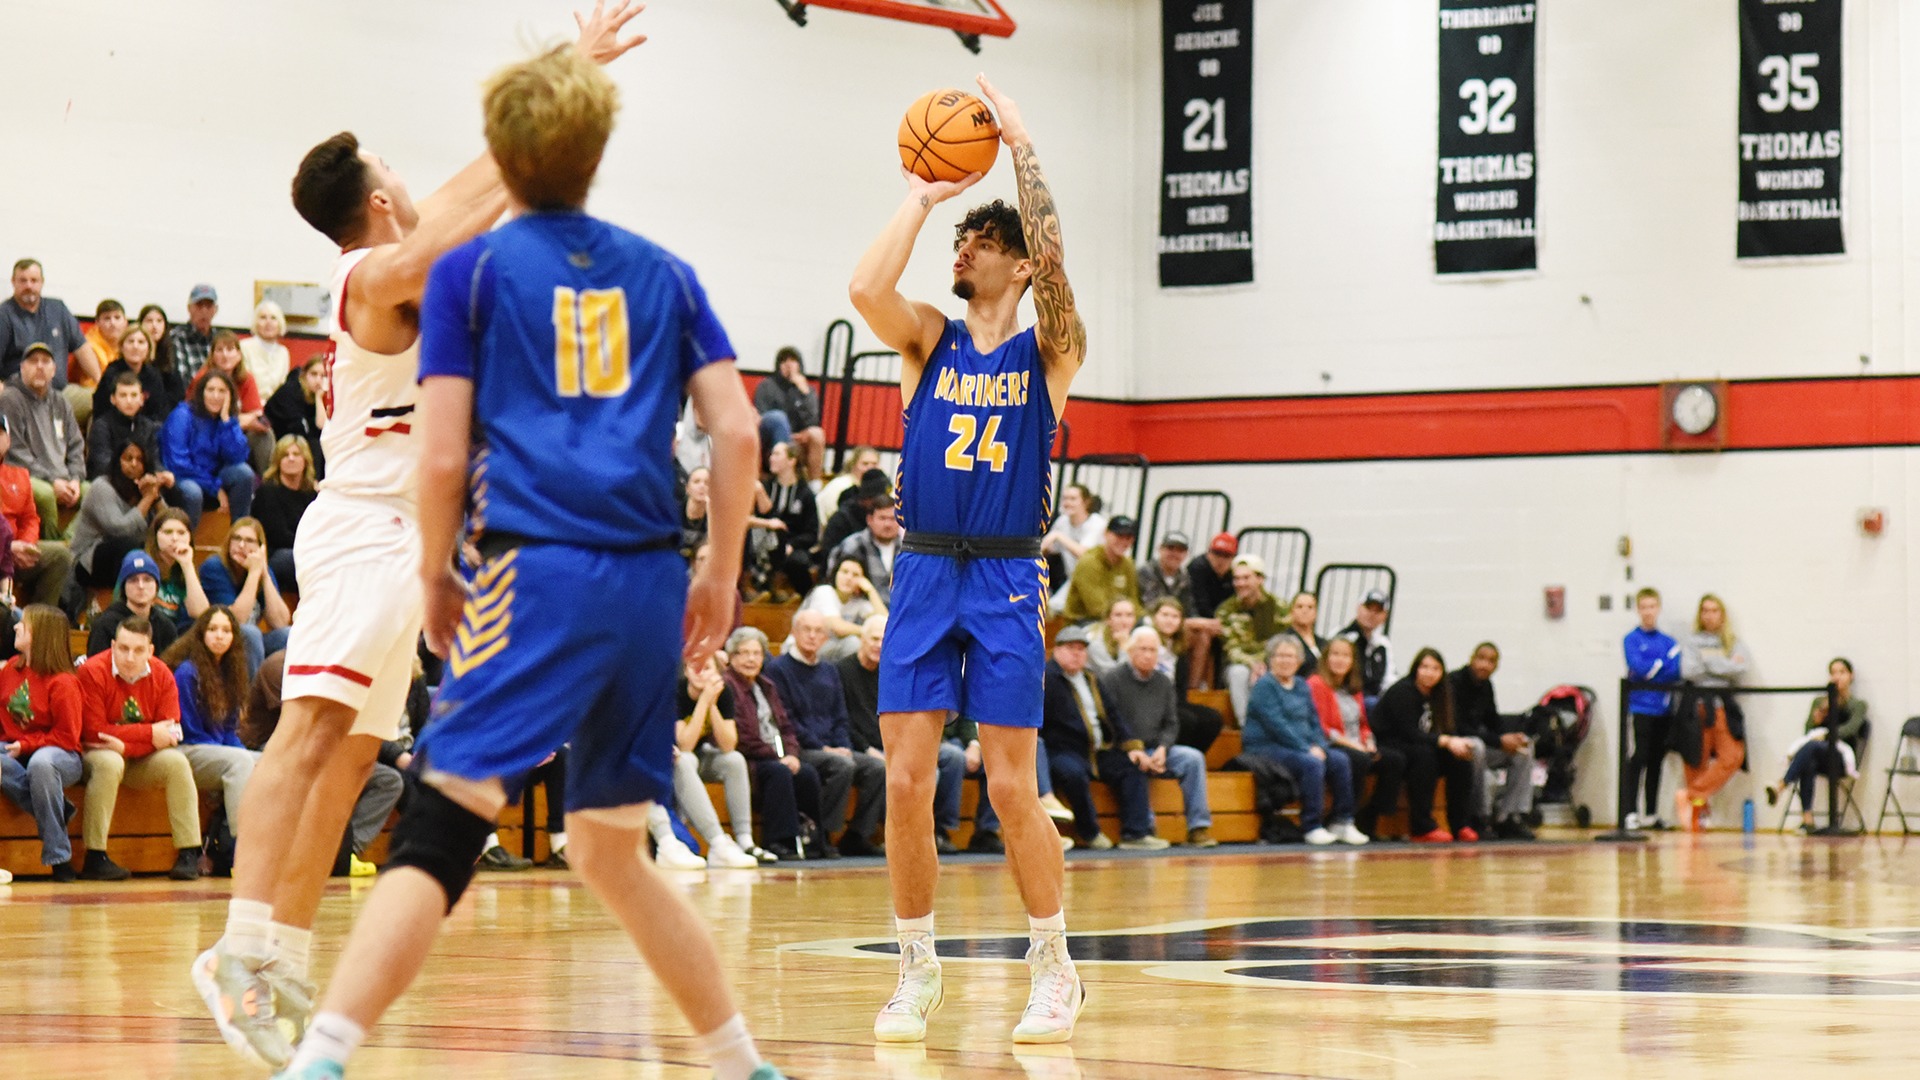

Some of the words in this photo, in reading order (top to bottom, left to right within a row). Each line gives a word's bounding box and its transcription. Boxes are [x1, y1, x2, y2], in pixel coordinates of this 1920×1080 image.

[1757, 52, 1820, 113] 35
[1458, 77, 1518, 135] 32
[1182, 97, 1228, 152] 21
[1739, 129, 1841, 161] THOMAS
[1165, 168, 1250, 199] THOMAS
[1439, 152, 1534, 185] THOMAS
[1755, 167, 1825, 191] WOMENS
[1738, 197, 1842, 222] BASKETBALL
[1156, 230, 1252, 254] BASKETBALL
[1436, 217, 1535, 242] BASKETBALL
[552, 285, 632, 398] 10
[933, 366, 1030, 407] MARINERS
[945, 413, 1008, 473] 24
